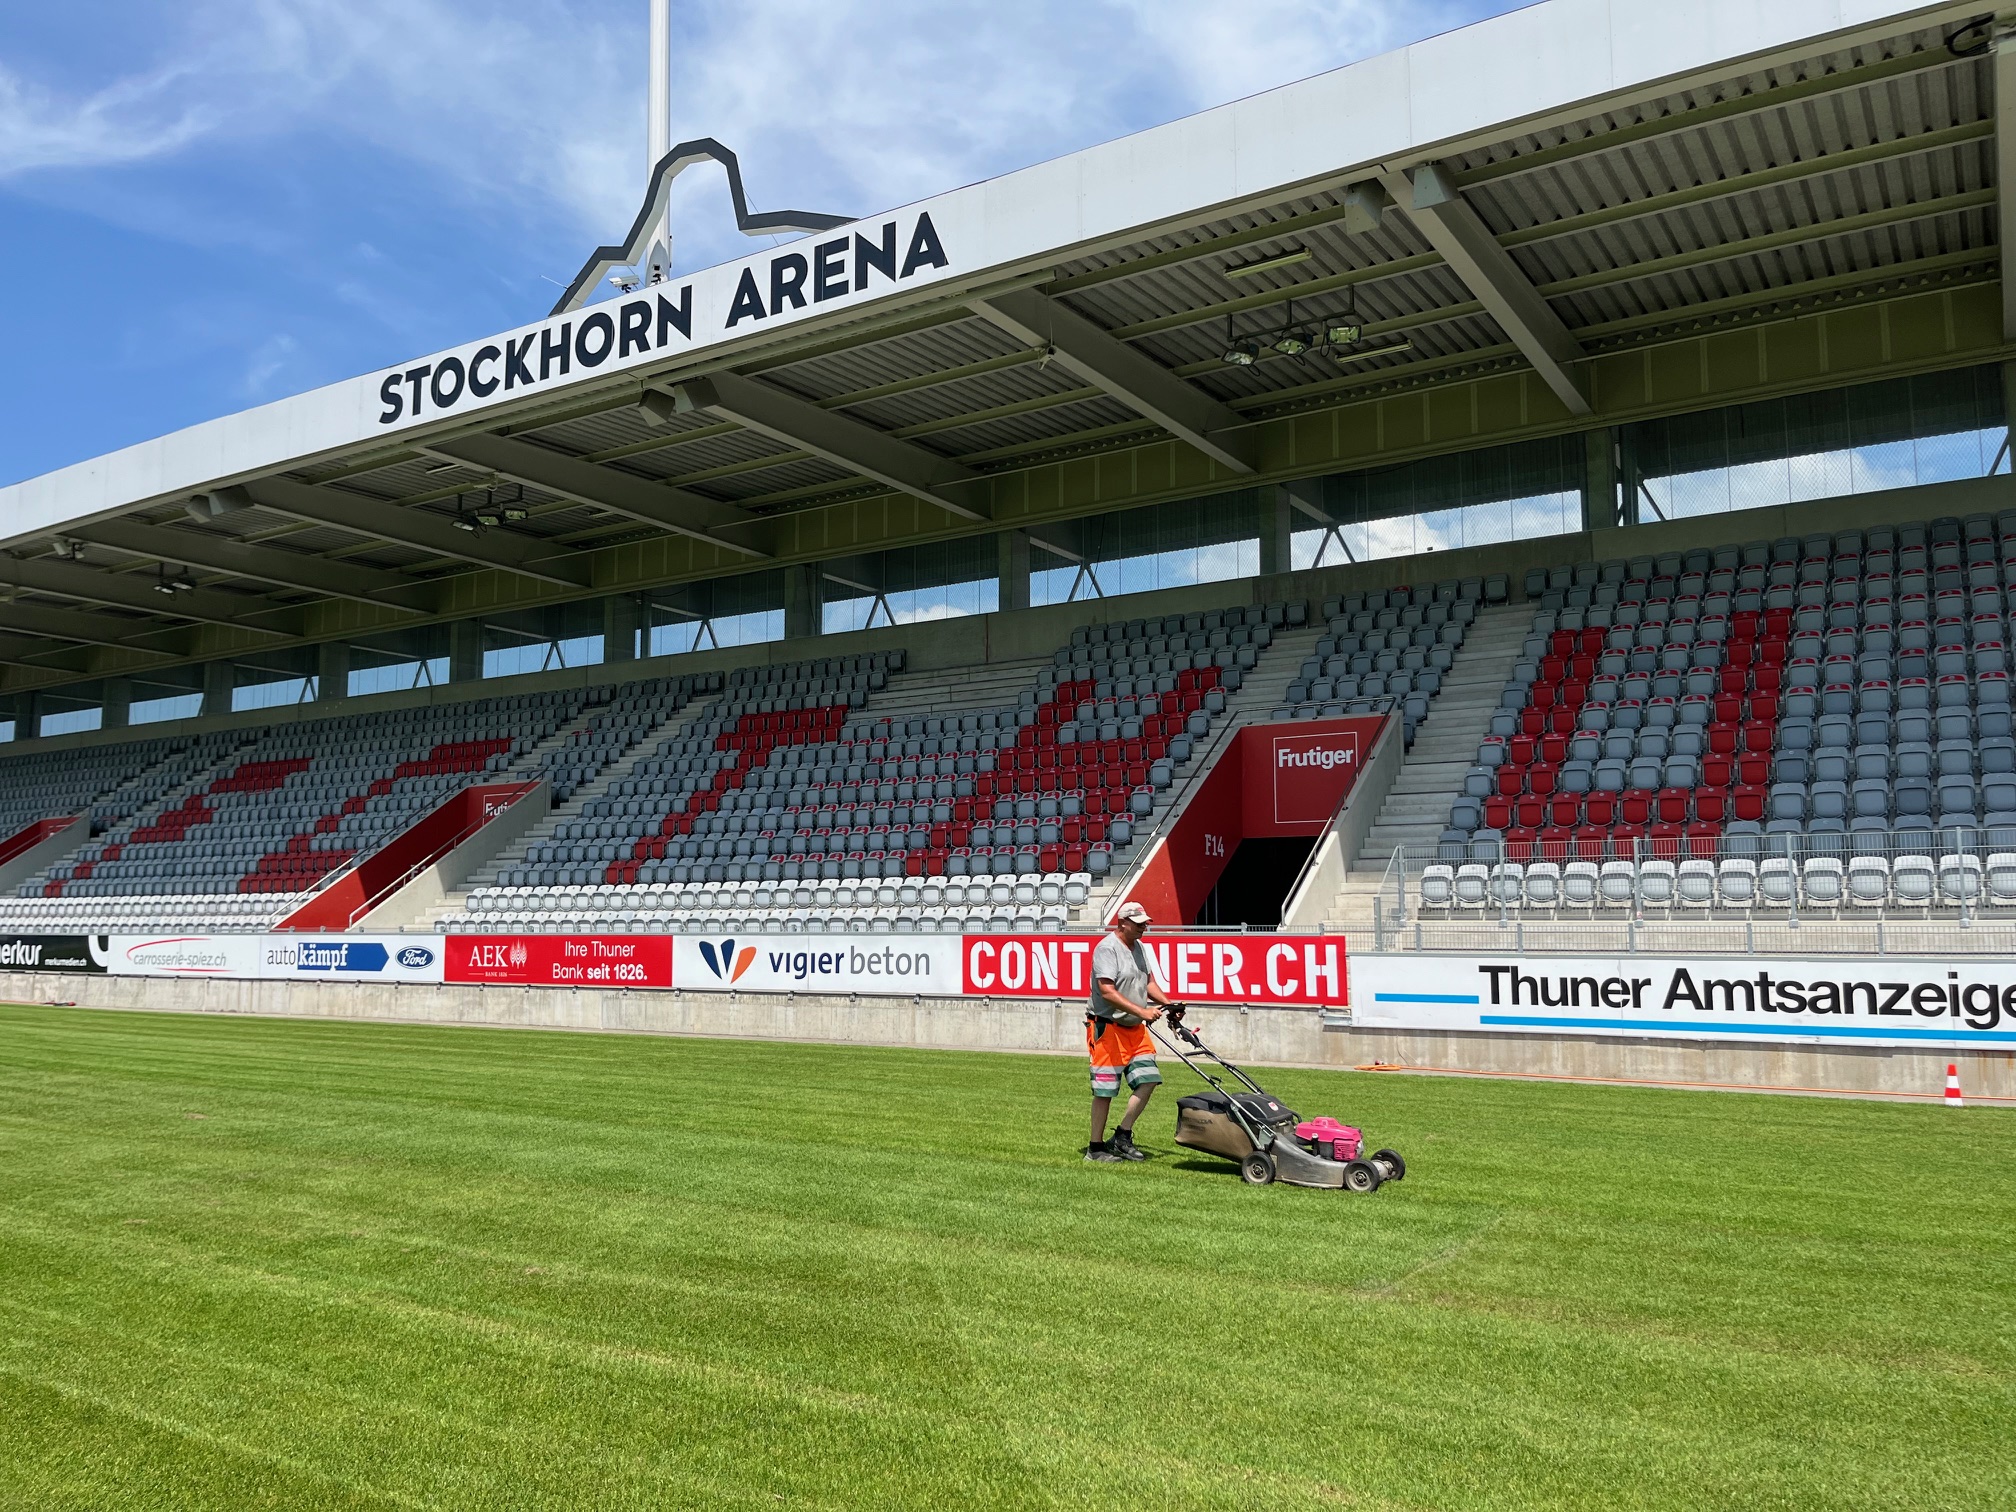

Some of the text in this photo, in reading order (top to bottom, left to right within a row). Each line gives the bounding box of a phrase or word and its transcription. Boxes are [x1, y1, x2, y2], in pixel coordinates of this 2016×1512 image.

[379, 211, 949, 424] STOCKHORN ARENA
[1278, 746, 1353, 769] Frutiger
[1205, 834, 1224, 857] F14
[0, 940, 42, 966] erkur
[133, 951, 227, 968] carrosserie-spiez.ch
[402, 949, 427, 966] Ford
[468, 945, 508, 968] AEK
[565, 941, 636, 958] Ihre Thuner
[553, 963, 648, 981] Bank seit 1826.
[970, 940, 1339, 998] CONTNER.CH
[1478, 965, 1652, 1009] Thuner
